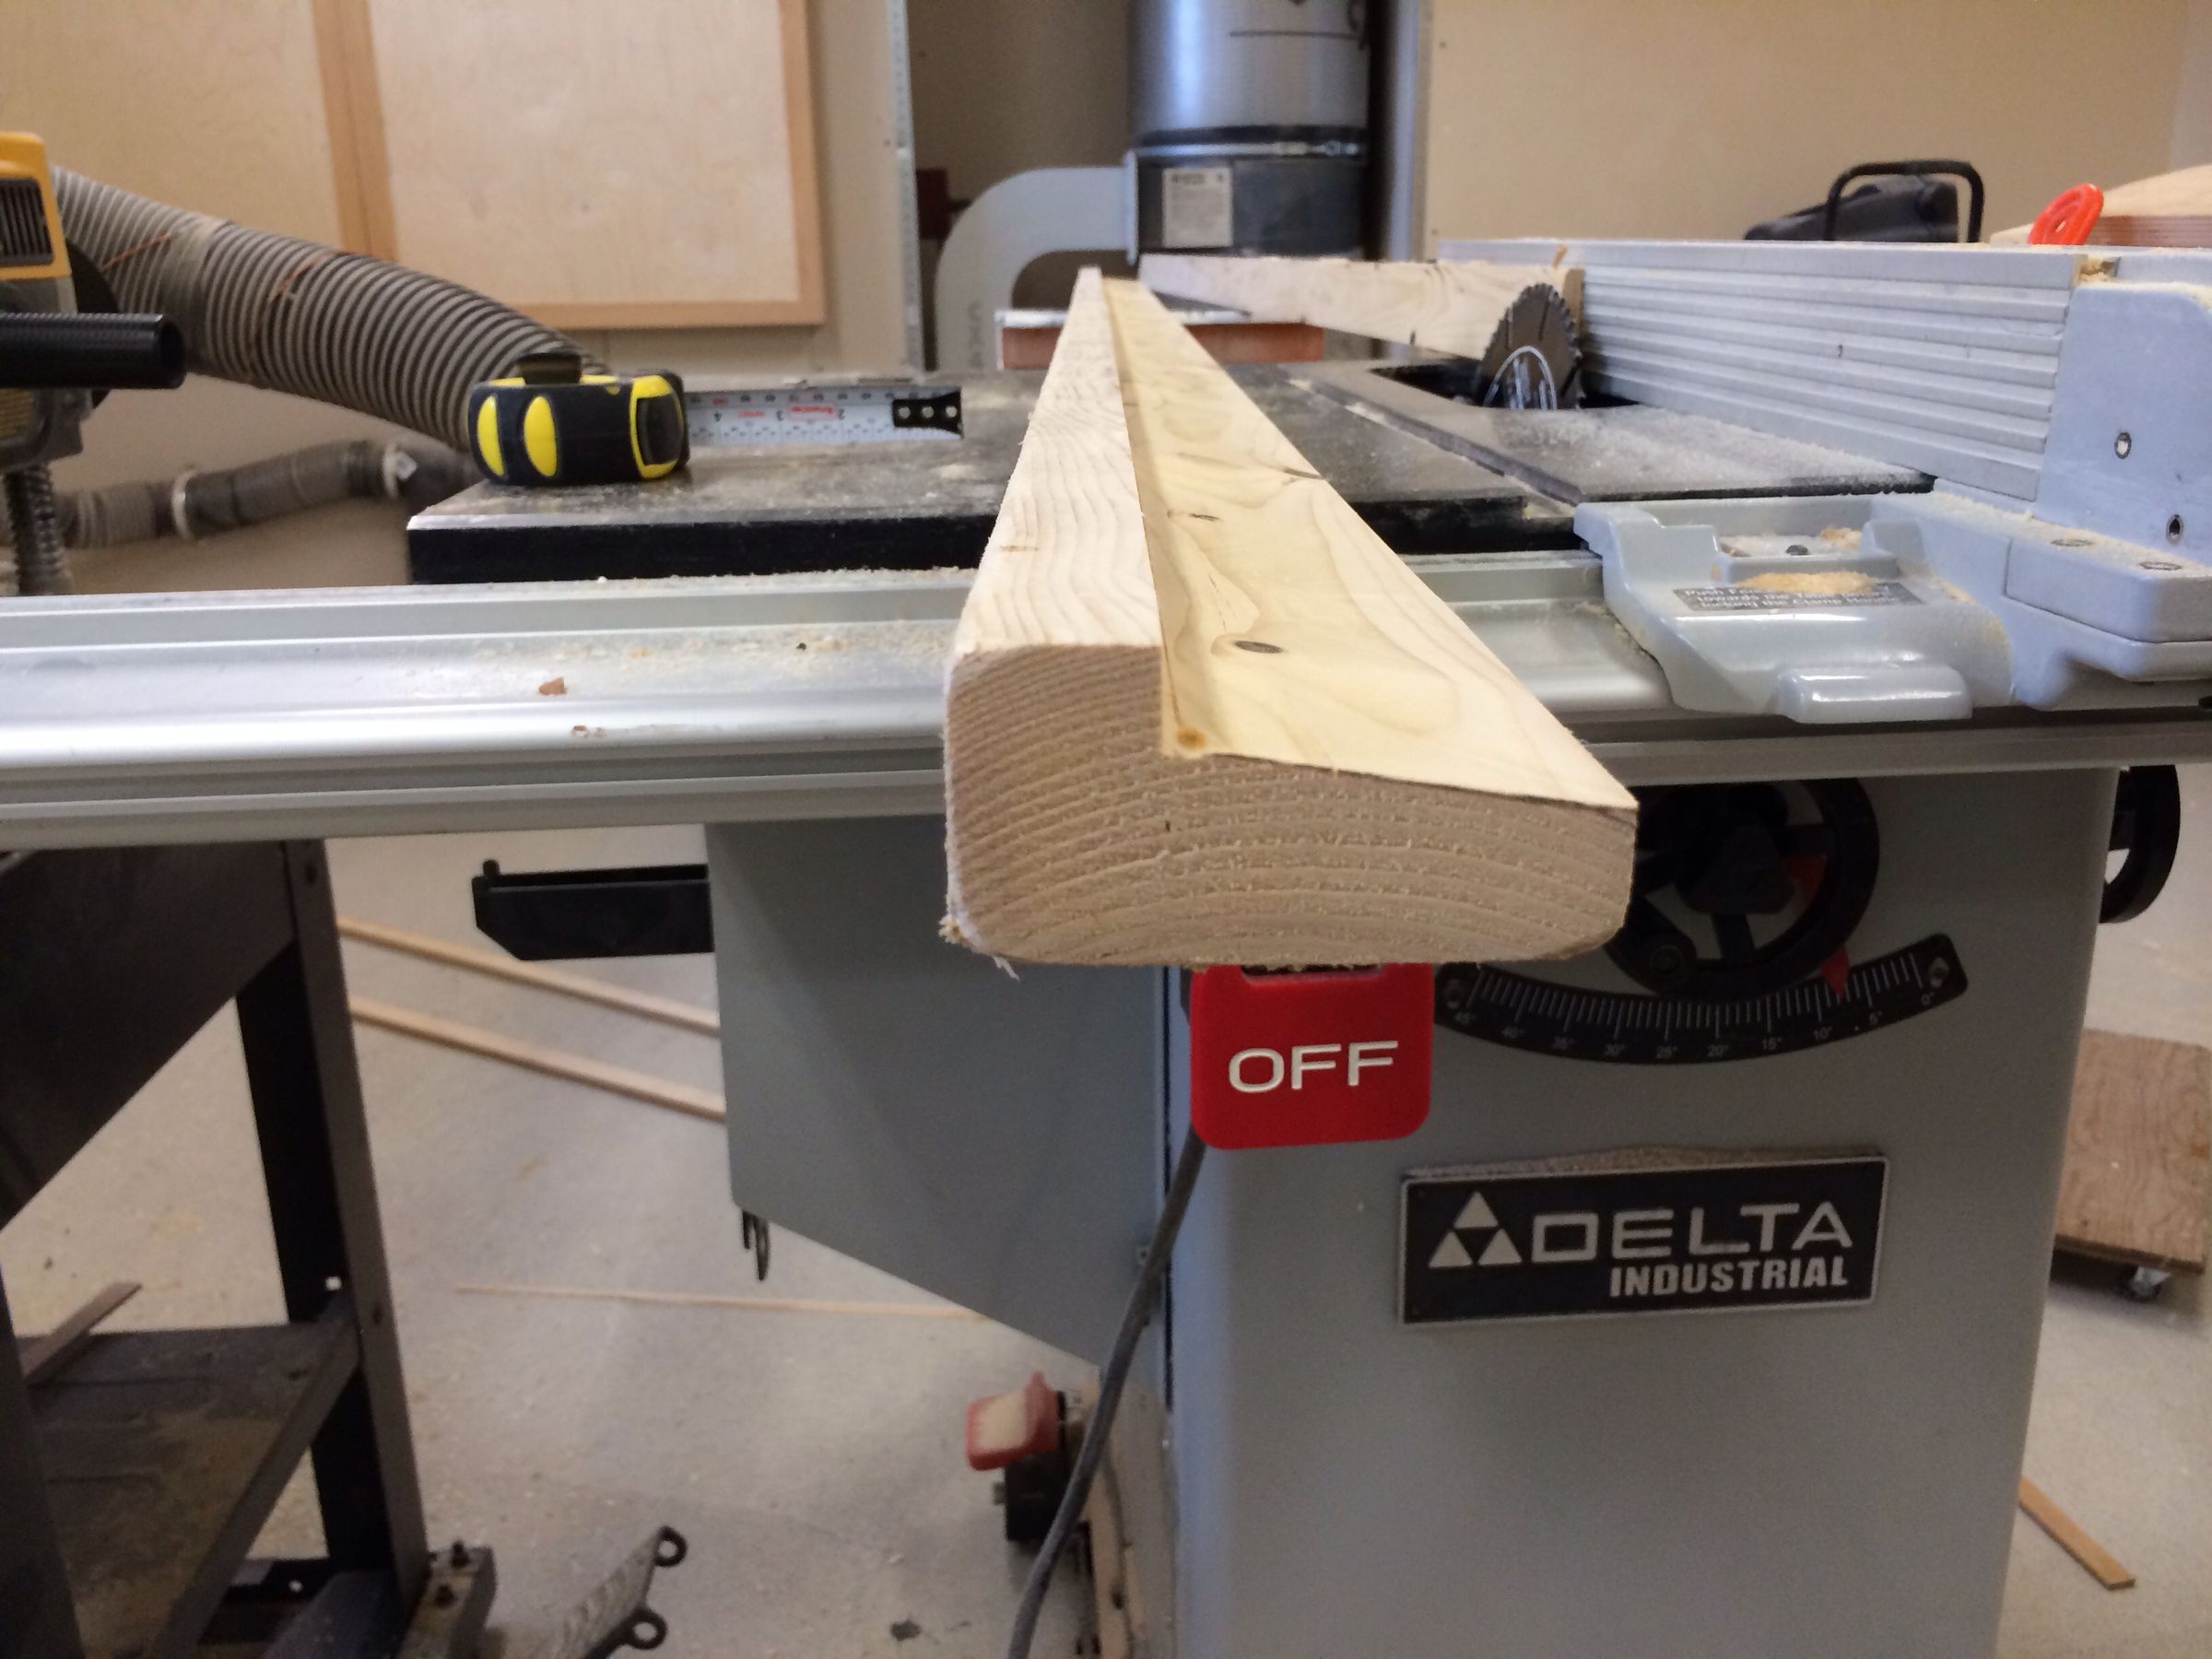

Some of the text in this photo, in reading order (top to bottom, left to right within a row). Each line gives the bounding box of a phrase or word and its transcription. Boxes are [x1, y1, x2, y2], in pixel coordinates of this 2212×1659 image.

[1228, 1040, 1399, 1094] OFF
[1531, 1200, 1854, 1264] DELTA
[1608, 1255, 1849, 1298] INDUSTRIAL
